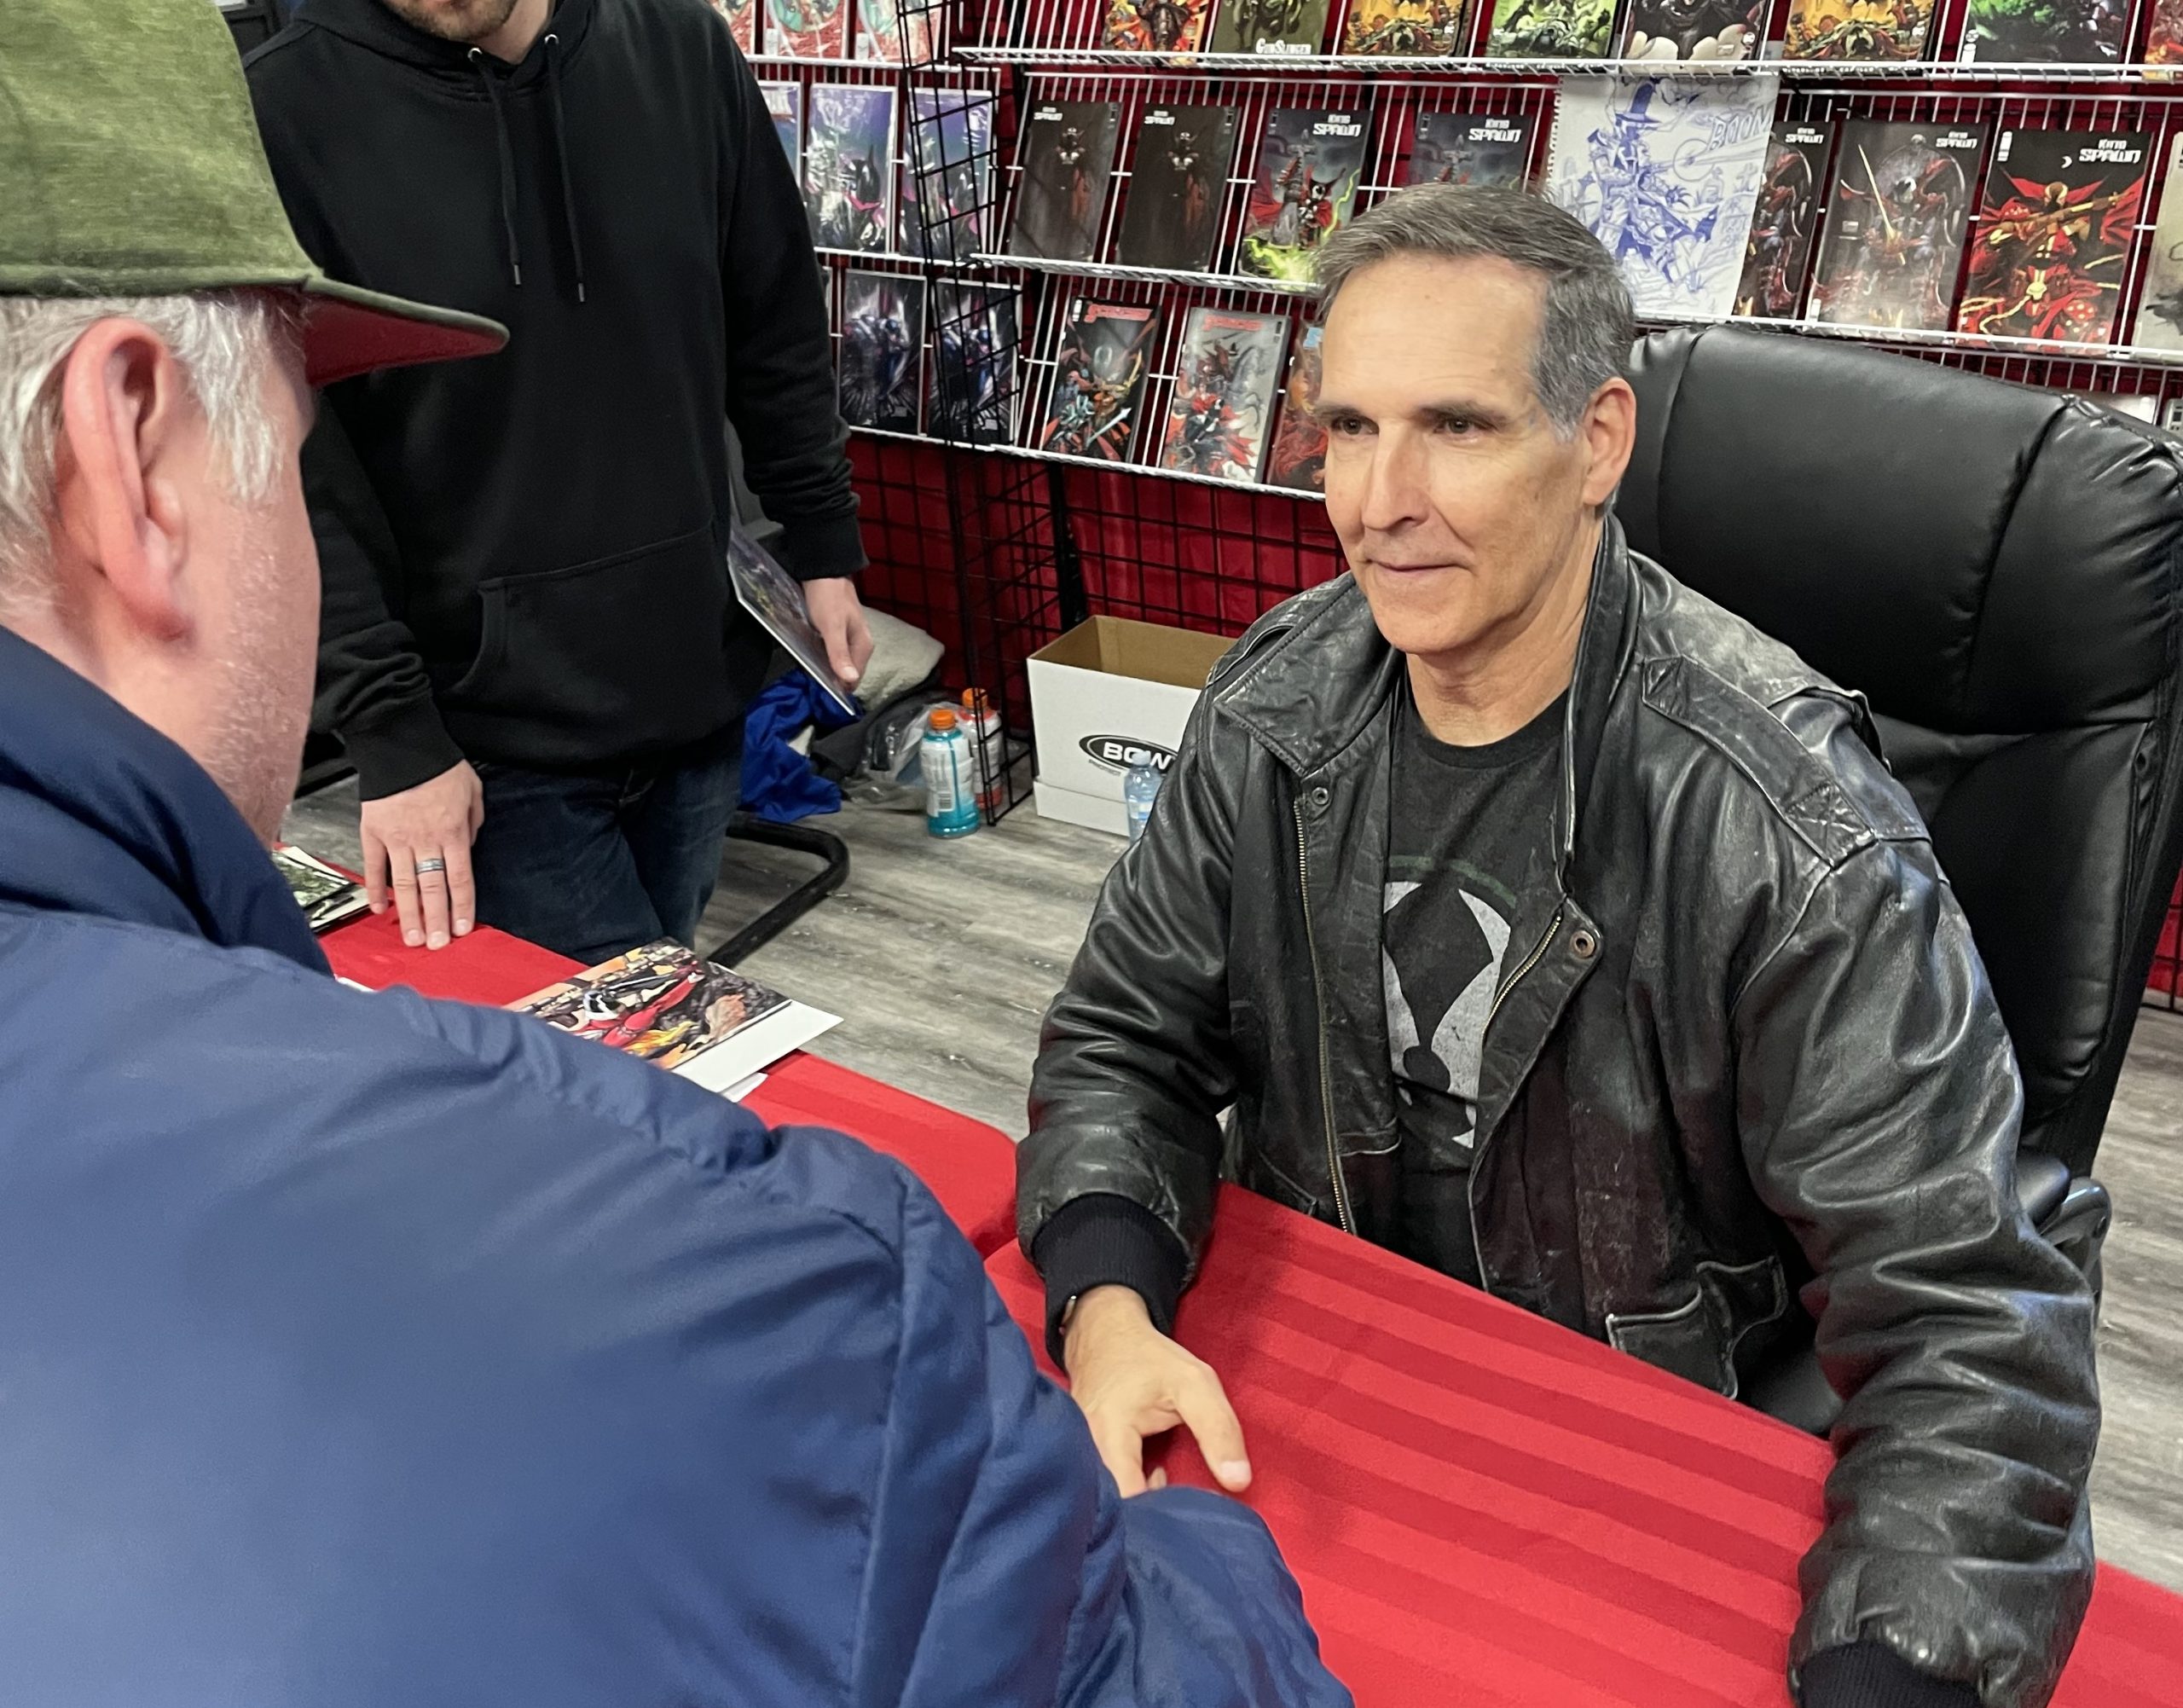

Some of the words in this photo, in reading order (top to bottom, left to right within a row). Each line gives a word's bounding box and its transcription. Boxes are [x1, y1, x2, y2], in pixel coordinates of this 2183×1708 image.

[1312, 123, 1363, 137] SPAWN
[1468, 128, 1522, 143] SPAWN
[2078, 148, 2142, 165] SPAWN
